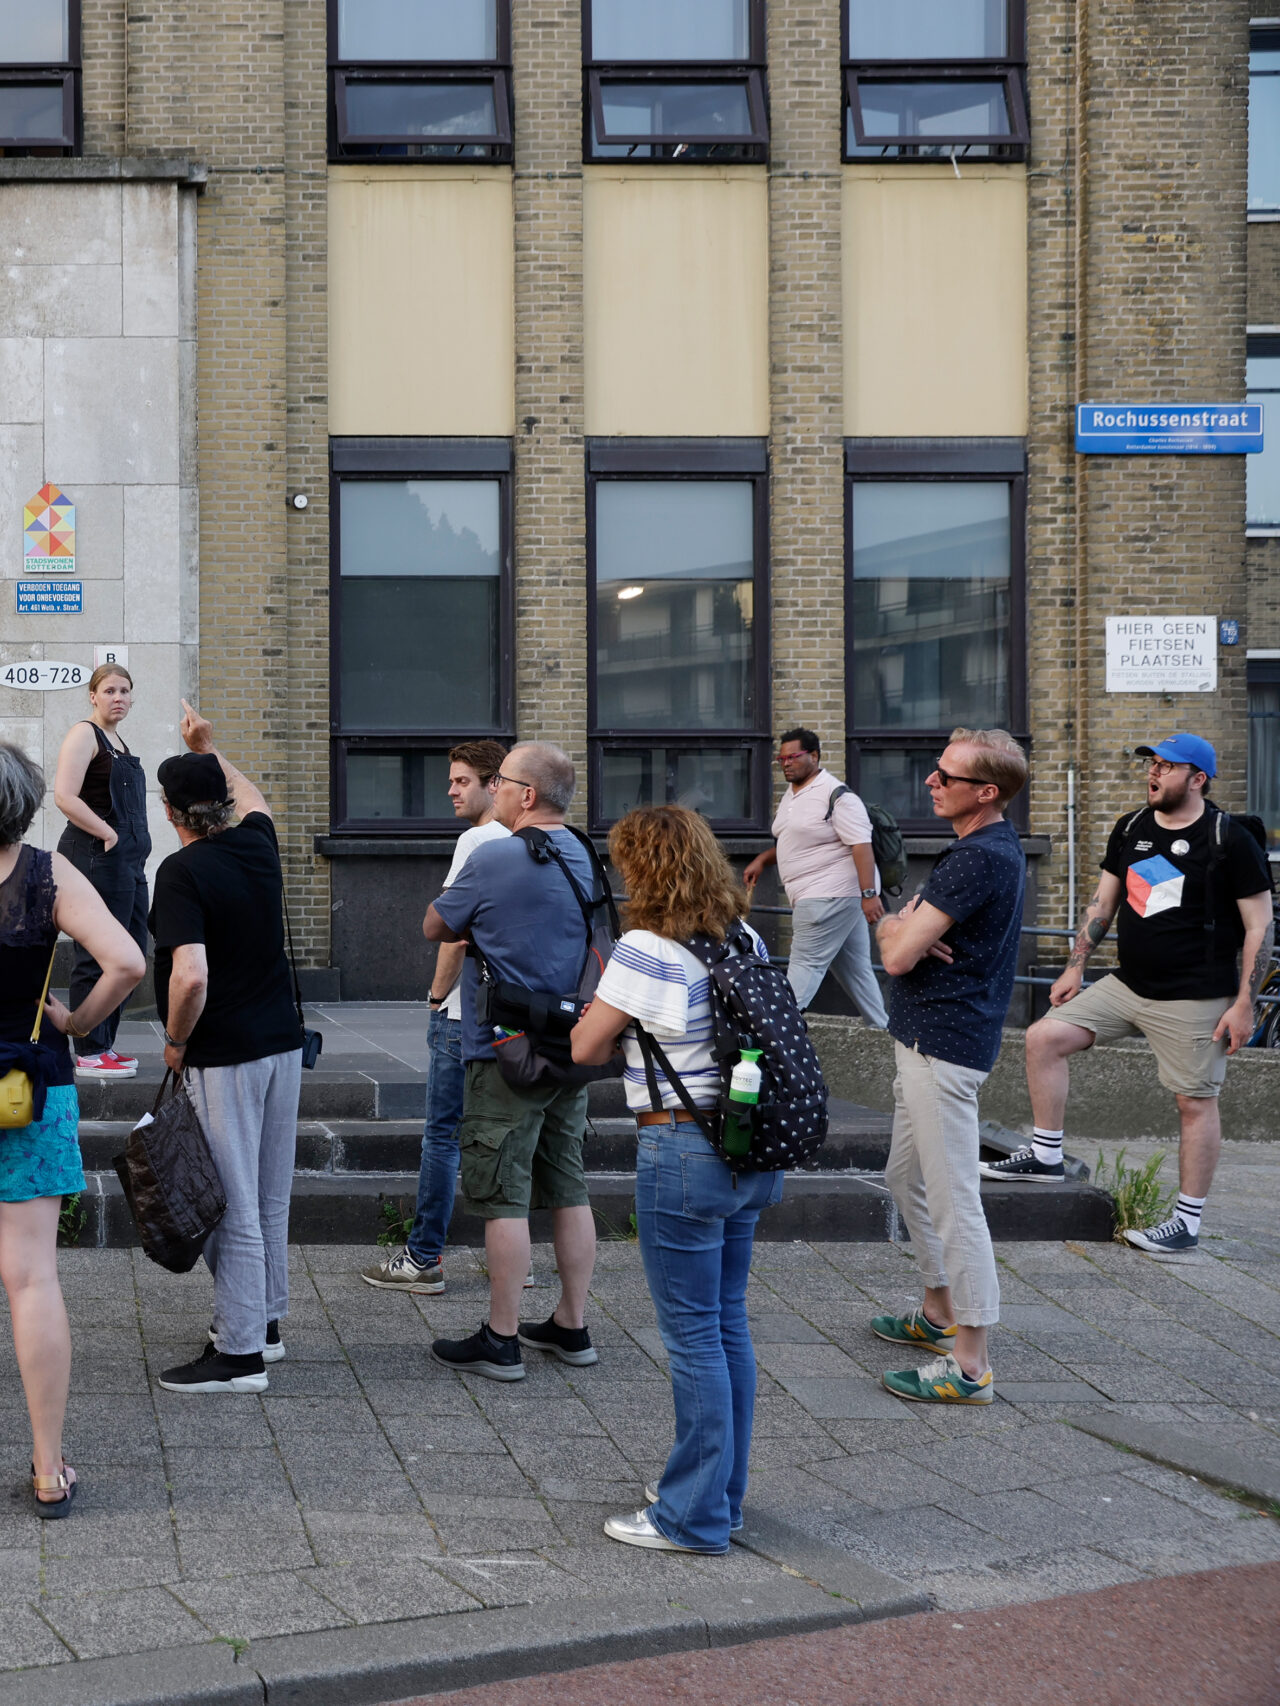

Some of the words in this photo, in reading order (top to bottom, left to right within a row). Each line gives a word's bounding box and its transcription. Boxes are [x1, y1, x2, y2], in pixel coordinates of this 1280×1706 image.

[1092, 410, 1249, 428] Rochussenstraat
[18, 583, 51, 592] VERBODEN
[52, 583, 81, 592] TOEGANG
[18, 593, 36, 602] VOOR
[36, 593, 81, 602] ONBEVOEGDEN
[1116, 622, 1153, 635] HIER
[1162, 622, 1207, 635] GEEN
[1128, 638, 1195, 651] FIETSEN
[106, 653, 116, 663] B
[1120, 654, 1203, 667] PLAATSEN
[4, 667, 82, 684] 408-728
